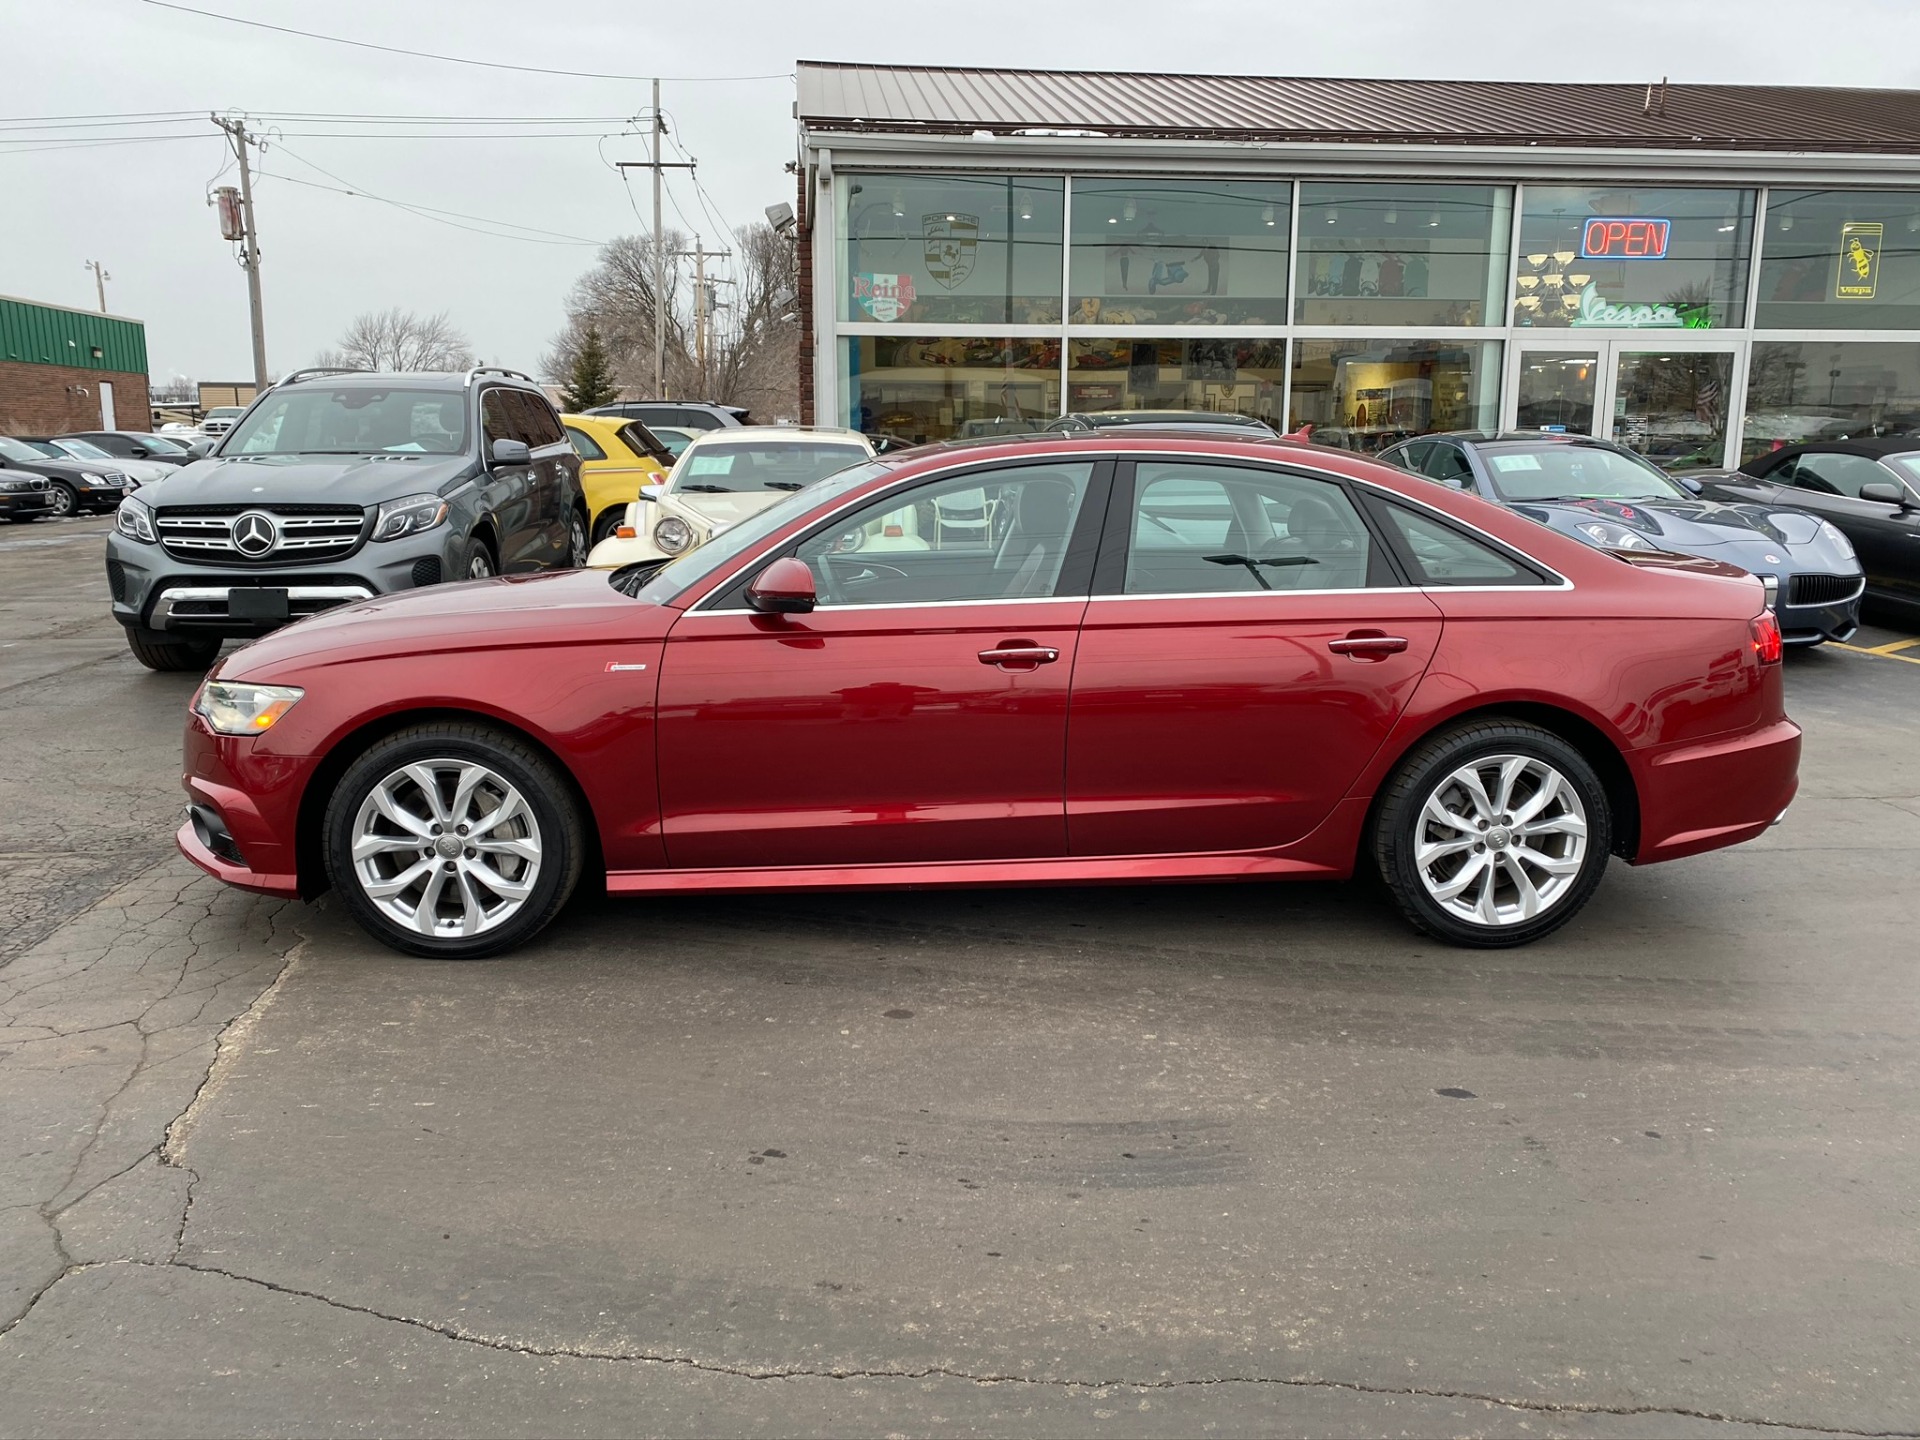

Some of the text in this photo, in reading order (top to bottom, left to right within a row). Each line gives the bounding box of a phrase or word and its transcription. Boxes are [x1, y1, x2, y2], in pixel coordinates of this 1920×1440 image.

[924, 214, 977, 224] PORCHE
[1587, 222, 1666, 255] OPEN
[853, 276, 917, 301] Reina
[1840, 286, 1872, 295] Vespa
[1580, 281, 1677, 327] Vespa
